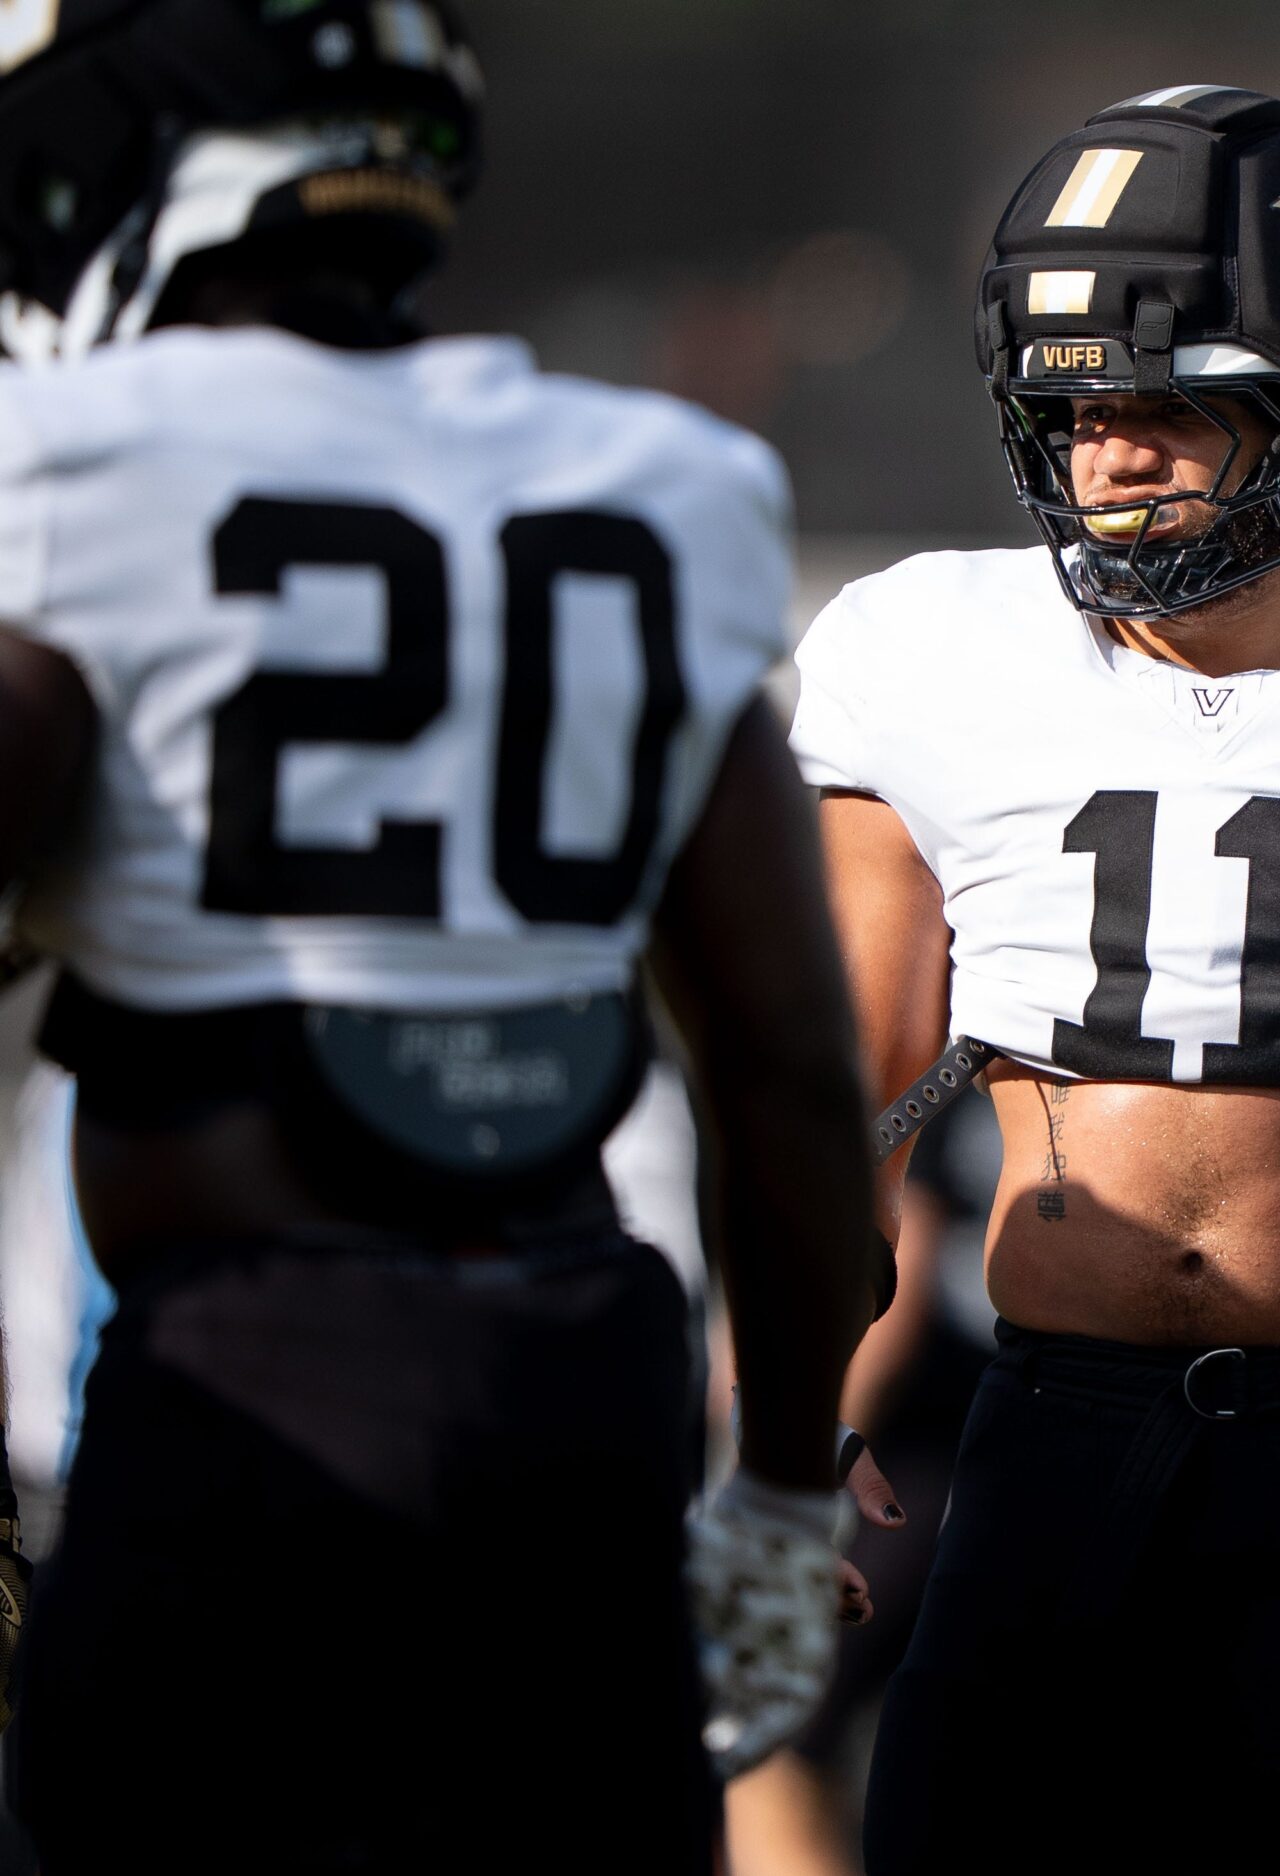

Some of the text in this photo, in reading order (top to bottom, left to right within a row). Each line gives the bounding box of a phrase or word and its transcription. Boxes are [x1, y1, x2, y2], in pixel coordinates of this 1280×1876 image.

[1042, 345, 1106, 371] VUFB
[201, 498, 688, 925] 20
[1191, 688, 1235, 716] V
